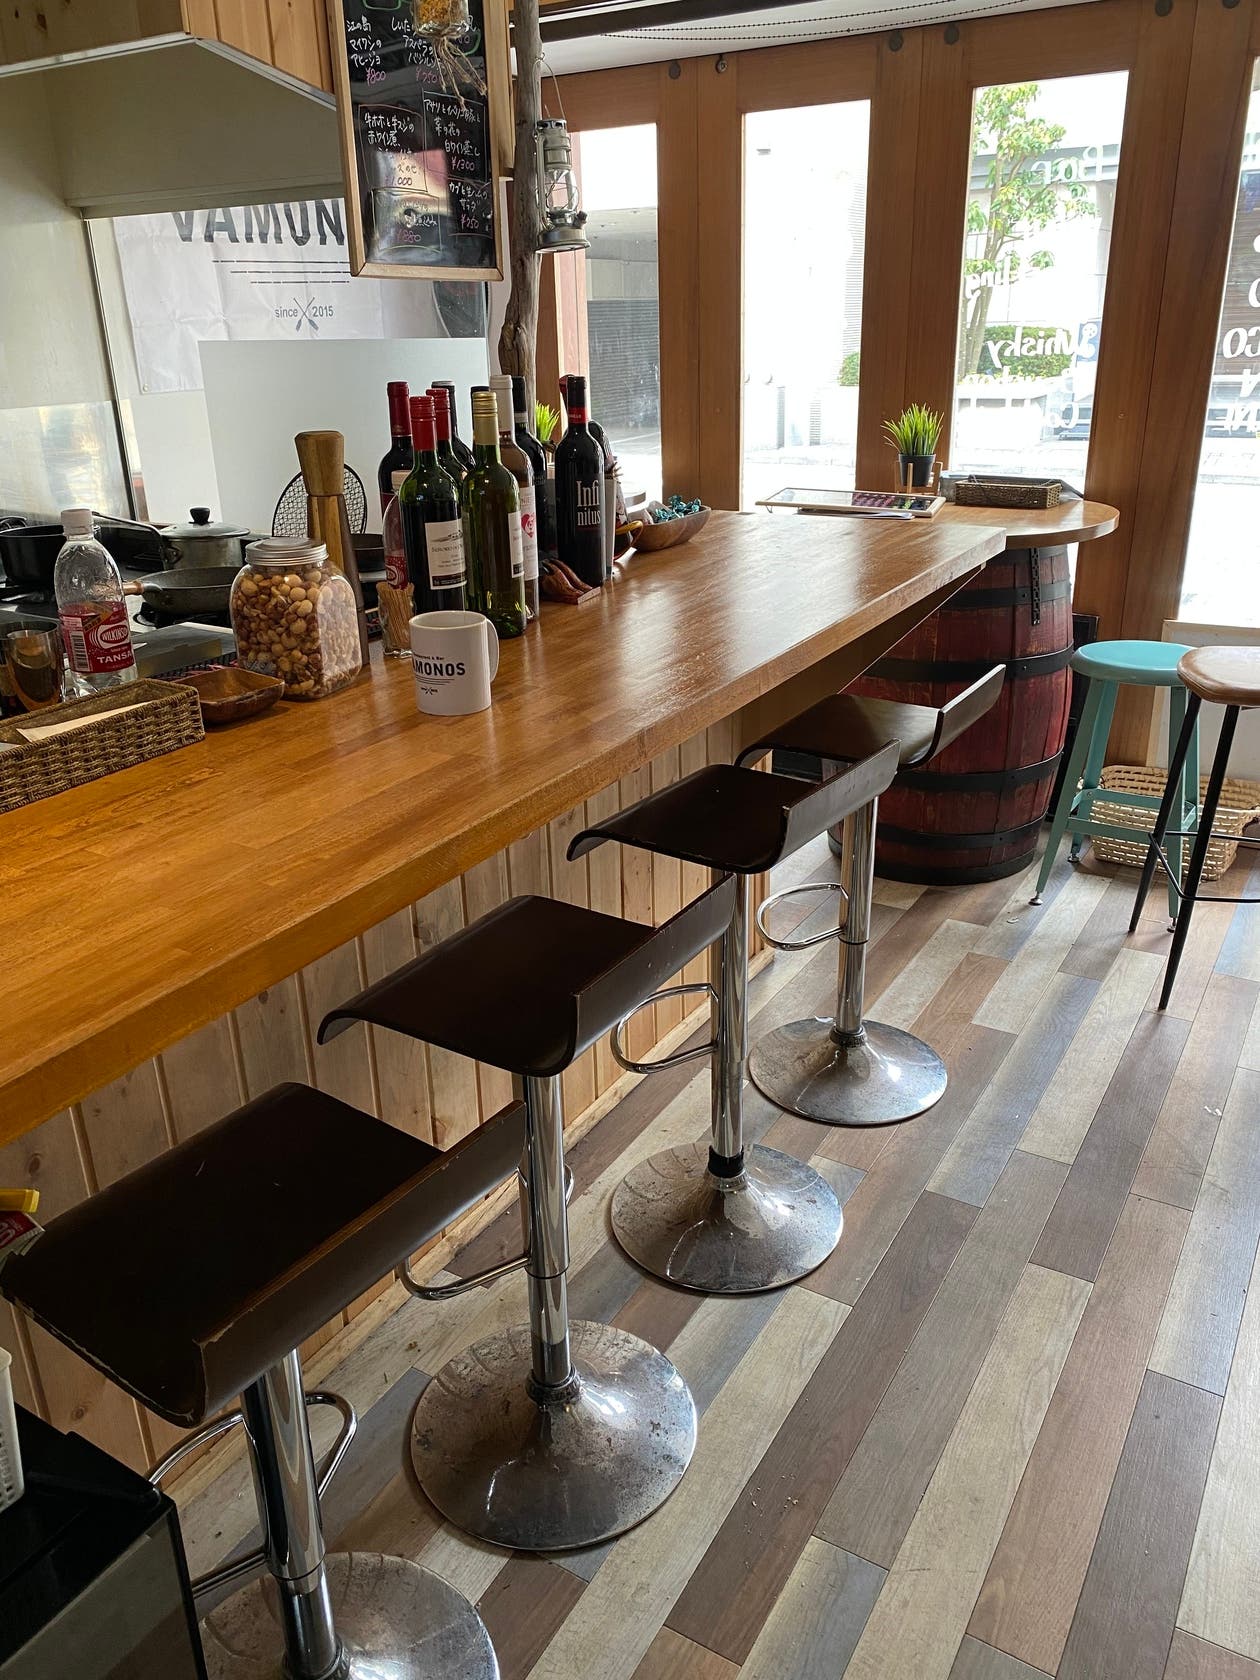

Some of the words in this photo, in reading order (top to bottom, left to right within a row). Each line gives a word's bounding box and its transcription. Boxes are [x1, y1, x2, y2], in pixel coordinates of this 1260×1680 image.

[391, 16, 415, 34] しいた
[349, 35, 382, 51] マイワシの
[350, 51, 382, 68] アヒージョ
[274, 306, 298, 318] since
[312, 305, 334, 318] 2015
[576, 507, 601, 526] nitus
